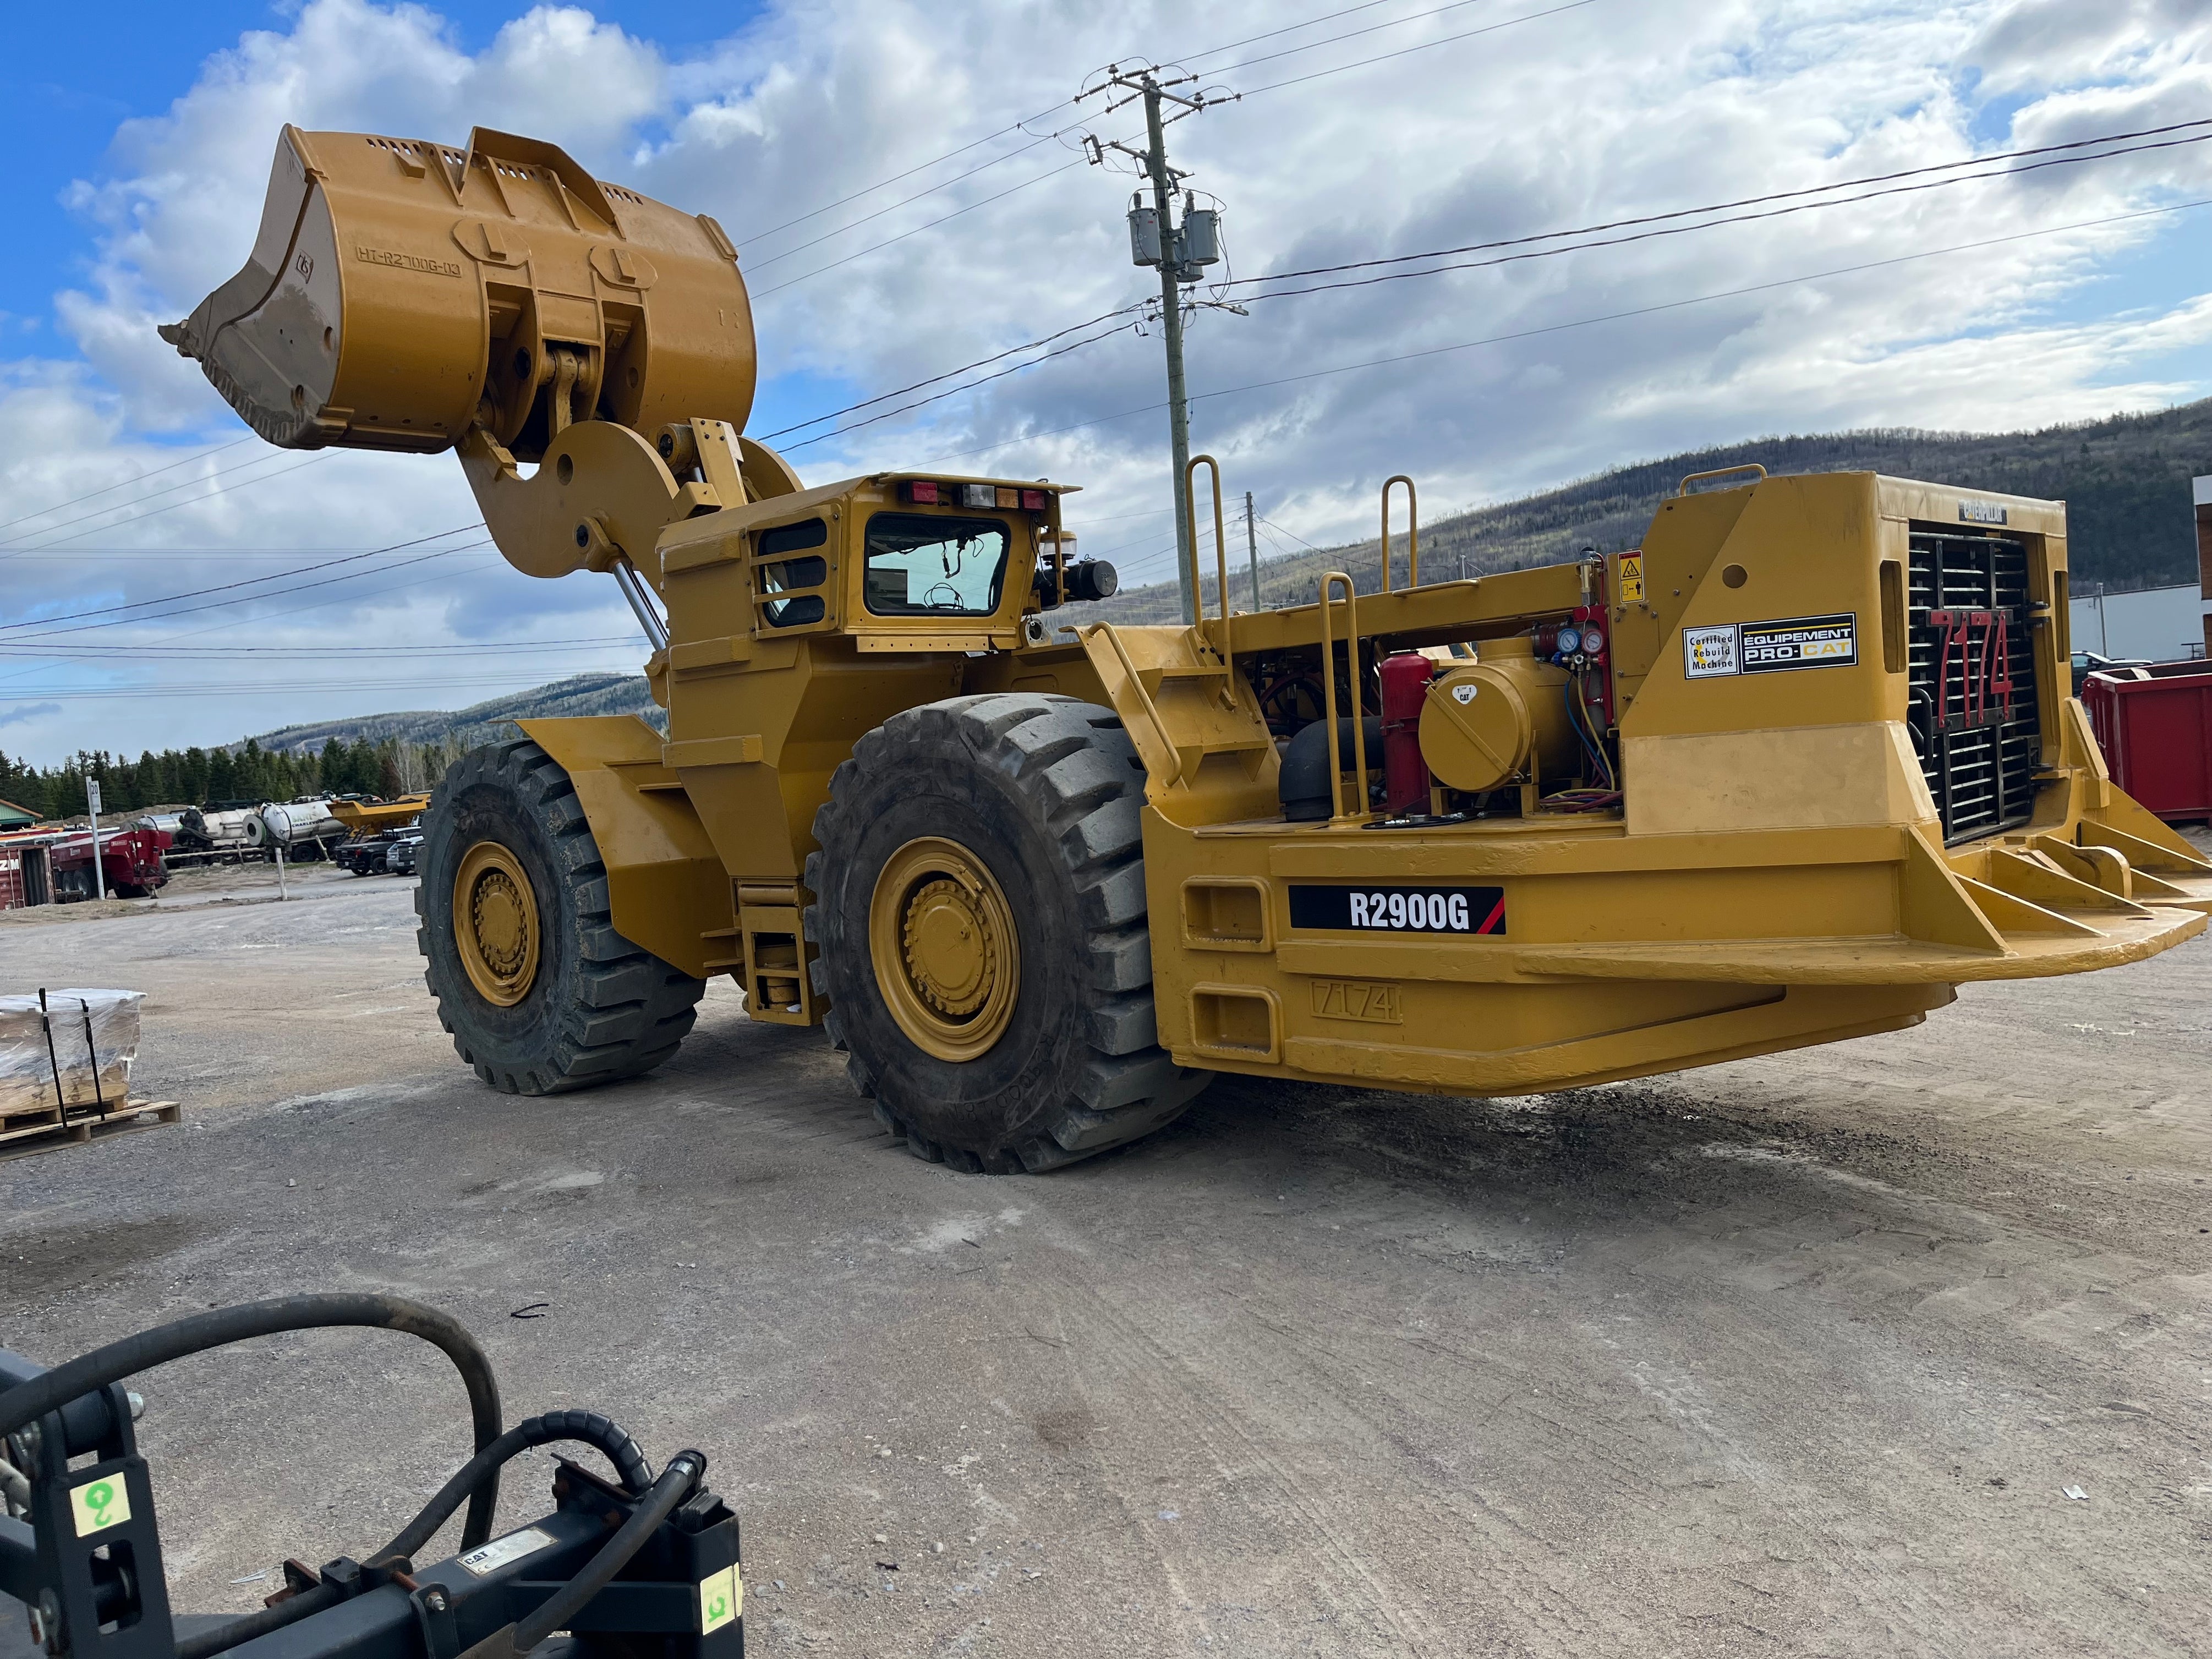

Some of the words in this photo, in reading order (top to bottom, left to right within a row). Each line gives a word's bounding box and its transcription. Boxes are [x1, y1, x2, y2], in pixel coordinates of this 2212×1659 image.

[1964, 502, 2003, 522] CATERPILLAR
[1689, 633, 1733, 646] Certified
[1744, 628, 1852, 646] ÉQUIPEMENT
[1693, 648, 1731, 658] Rebuild
[1745, 640, 1851, 662] PRO-CAT
[1691, 660, 1733, 670] Machine
[1930, 610, 2014, 728] 7174
[1349, 893, 1470, 930] R2900G
[1312, 982, 1393, 1020] 7174
[464, 1550, 489, 1565] CAT
